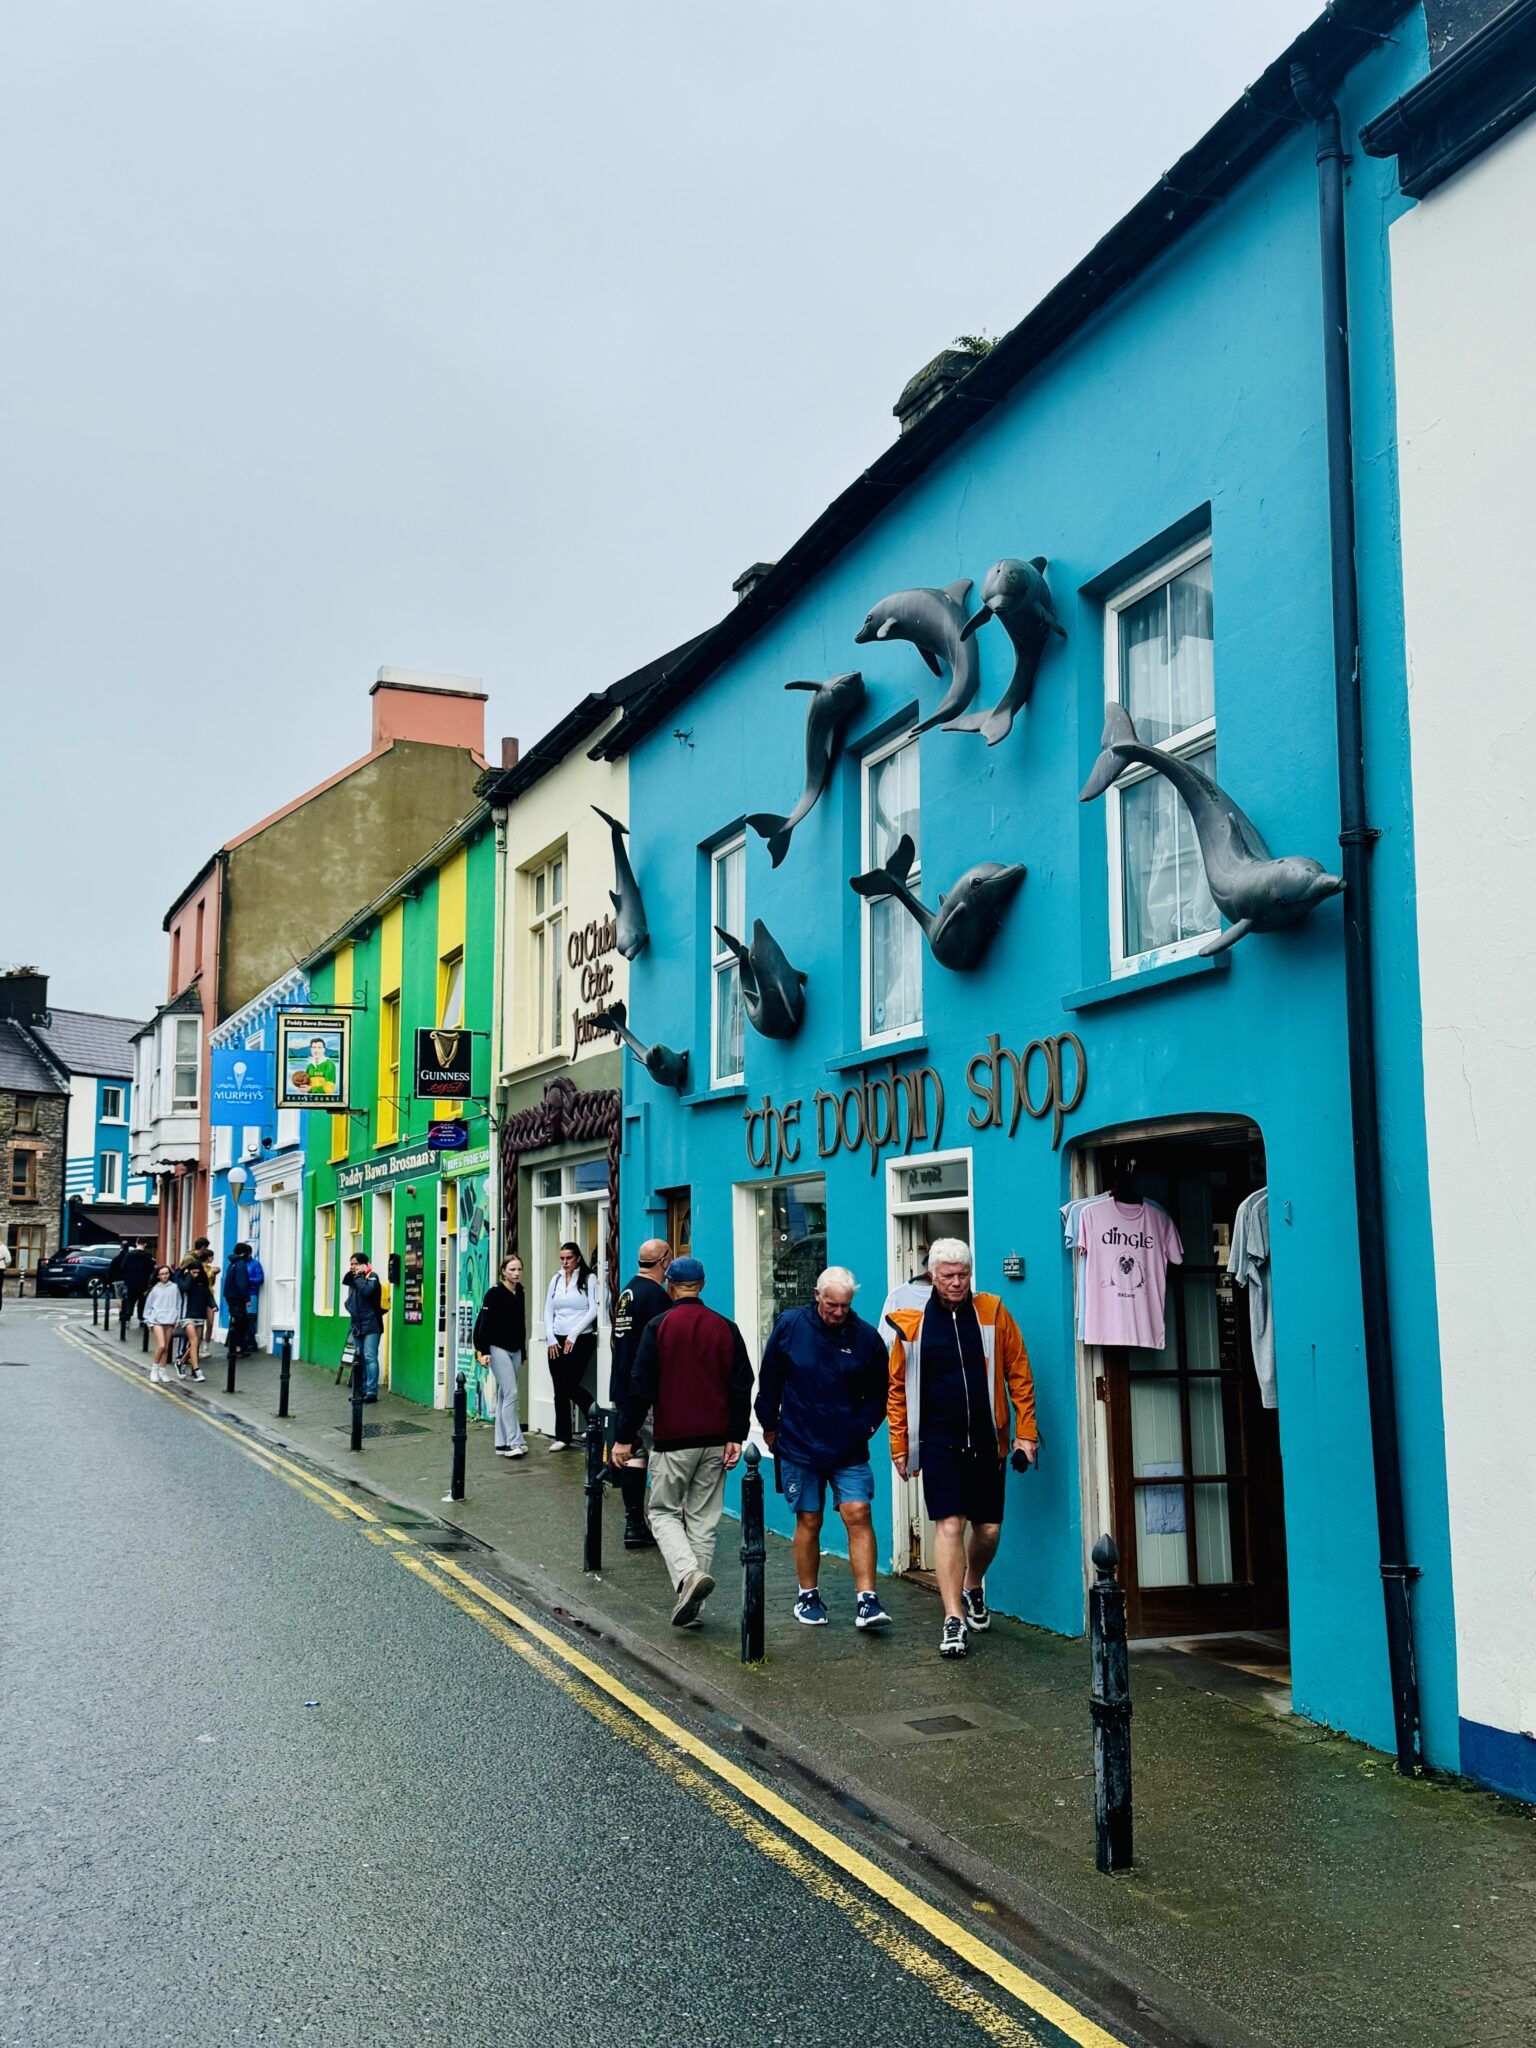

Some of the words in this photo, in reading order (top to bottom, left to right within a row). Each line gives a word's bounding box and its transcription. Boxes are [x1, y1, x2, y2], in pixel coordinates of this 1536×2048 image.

[420, 1069, 470, 1081] GUINNESS
[339, 1169, 363, 1189] Paddy
[364, 1163, 388, 1182] Bawn
[389, 1150, 436, 1174] Brosnan's
[1102, 1226, 1154, 1249] dingle
